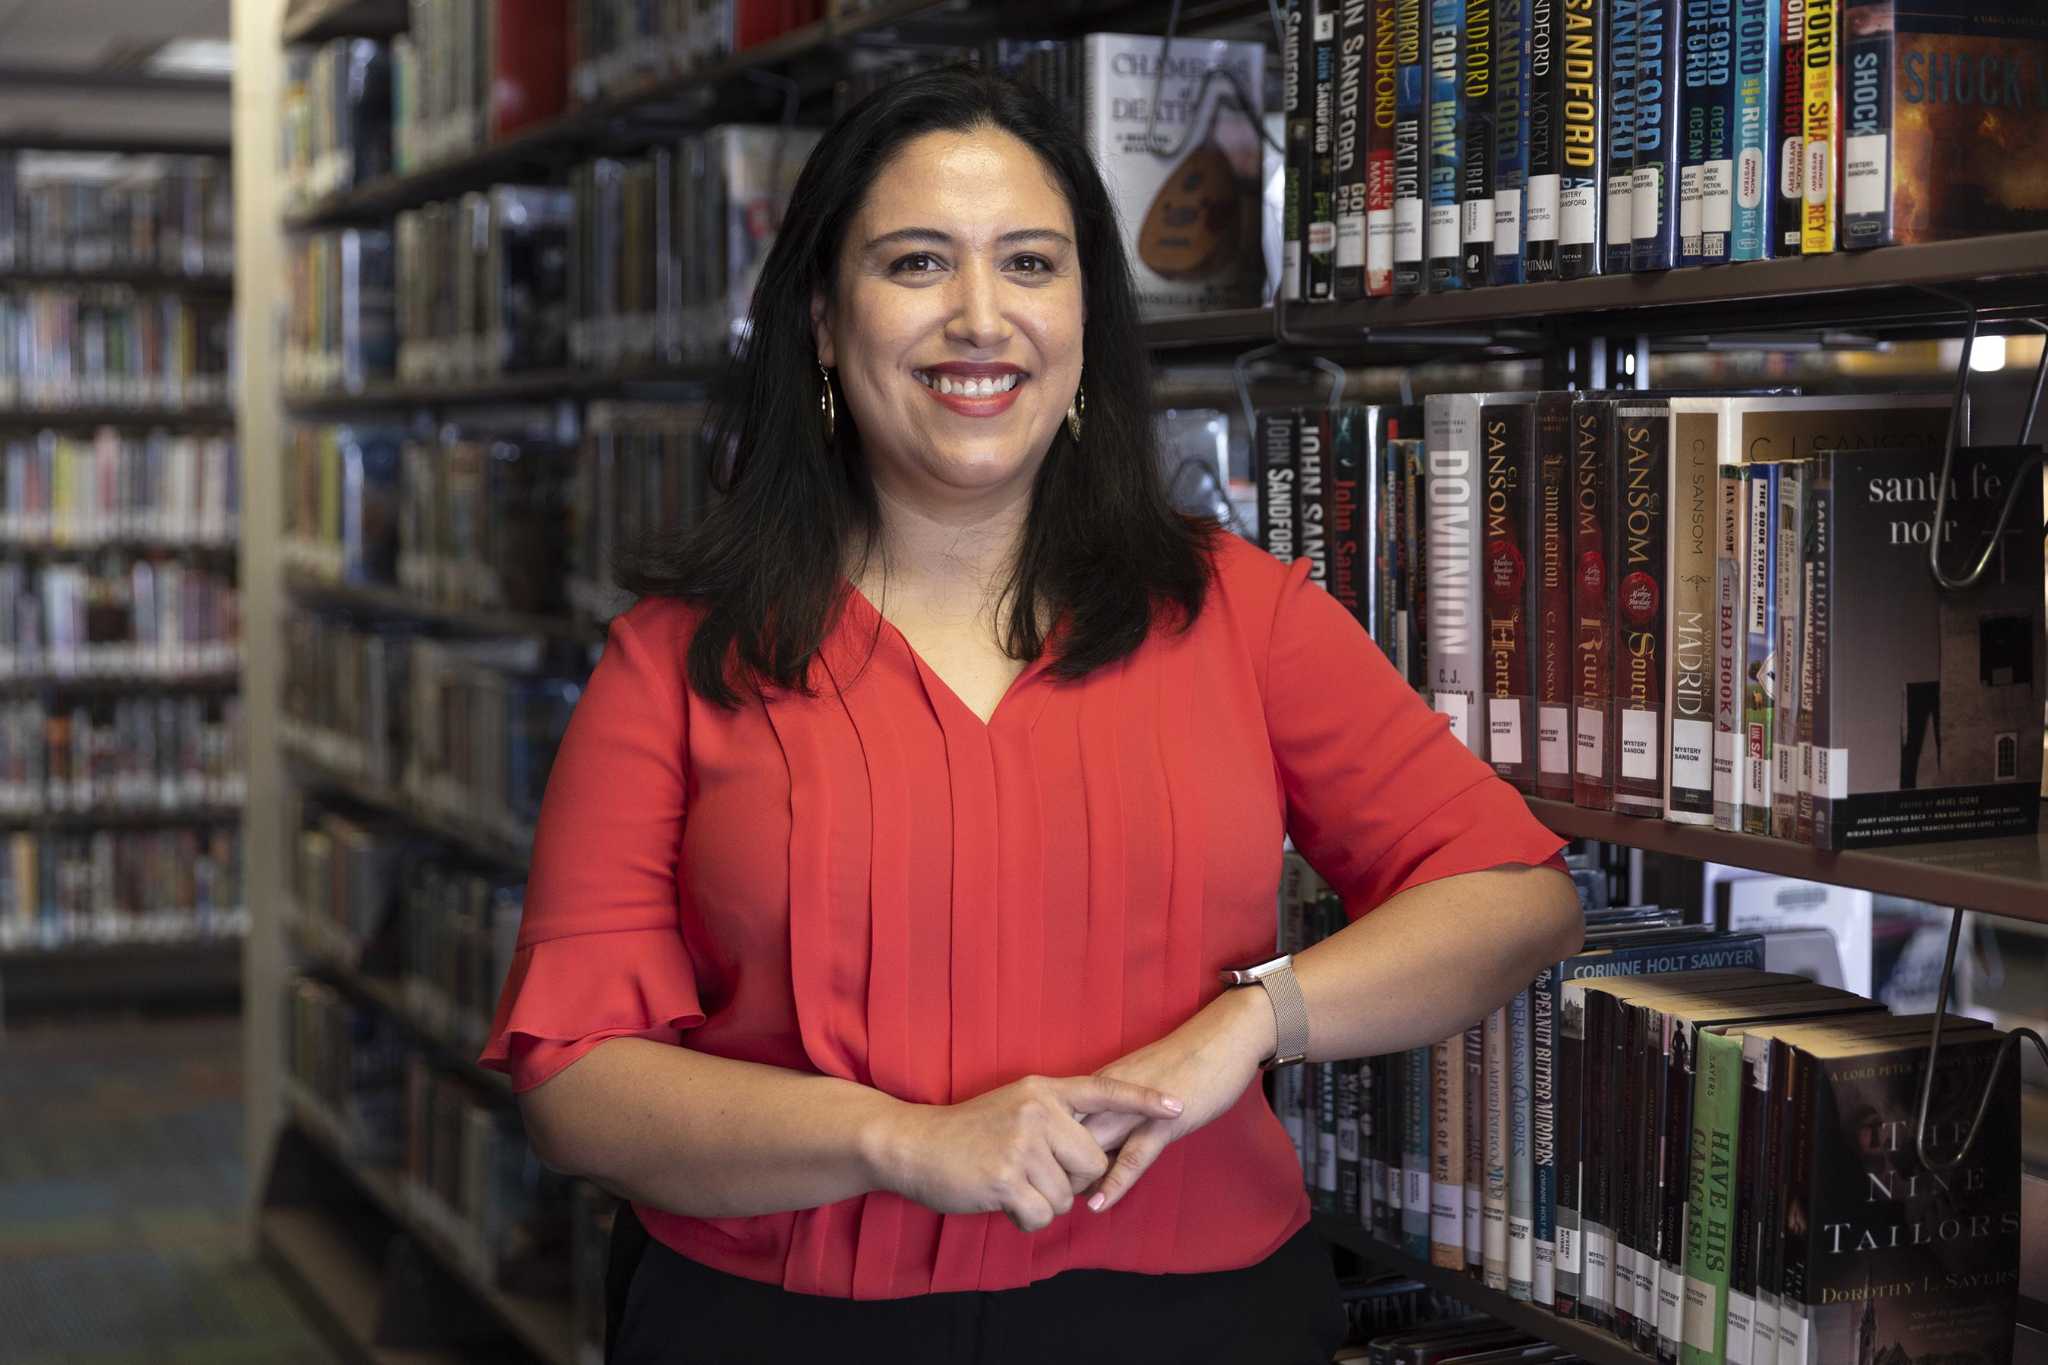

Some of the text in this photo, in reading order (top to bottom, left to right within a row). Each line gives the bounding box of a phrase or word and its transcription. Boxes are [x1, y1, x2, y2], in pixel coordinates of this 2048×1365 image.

[1375, 7, 1396, 129] SANDFORD
[1853, 52, 1878, 137] SHOCK
[1903, 50, 2023, 112] SHOCK
[1339, 34, 1365, 171] SANDFORD
[1432, 101, 1456, 158] HOLY
[1397, 120, 1418, 162] HEAT
[1689, 106, 1704, 160] OCEAN
[1710, 105, 1725, 159] OCEAN
[1787, 141, 1795, 193] MYSTERY
[1267, 418, 1293, 464] JOHN
[1488, 421, 1507, 537] SANSOM
[1578, 415, 1597, 535] SANSOM
[1627, 427, 1650, 565] SANSOM
[1972, 462, 2001, 499] fe
[1300, 417, 1327, 592] JOHN SAND
[1334, 480, 1357, 531] John
[1541, 453, 1563, 588] Lamentation
[1691, 474, 1705, 554] SANSOM
[1724, 485, 1735, 553] IAN SANSOM
[1758, 511, 1766, 545] BOOK
[1816, 500, 1826, 554] SANTA
[1889, 509, 1958, 545] nor
[1429, 450, 1471, 655] DOMINION
[1757, 549, 1765, 588] STOPS
[1816, 562, 1826, 578] FE
[1756, 596, 1764, 628] HERE
[1677, 611, 1703, 715] MADRID
[1703, 631, 1713, 698] WINTER IN
[1720, 577, 1733, 716] THE BAD BOOK
[1623, 740, 1647, 748] MYSTERY
[1623, 747, 1646, 755] SANSOM
[1674, 746, 1701, 755] MYSTERY
[1674, 753, 1699, 762] SANSOM
[1535, 967, 1552, 989] The
[1573, 949, 1755, 980] CORINNE HOLT SAWYER
[1535, 990, 1552, 1046] PEANUT
[1535, 1047, 1552, 1100] BUTTER
[1706, 1055, 1719, 1097] SAYERS
[1830, 1071, 1841, 1082] A
[1843, 1066, 1876, 1081] LORD
[1437, 1060, 1449, 1182] SECRETS OF WIS
[1512, 1083, 1529, 1157] CALORIES
[1535, 1101, 1554, 1167] MURDERS
[1705, 1127, 1731, 1273] HAVE HIS
[1866, 1166, 1985, 1204] NINE
[1823, 1209, 2020, 1255] TAILORS
[1821, 1281, 1915, 1304] DOROTHY
[1945, 1267, 2018, 1290] SAYERS
